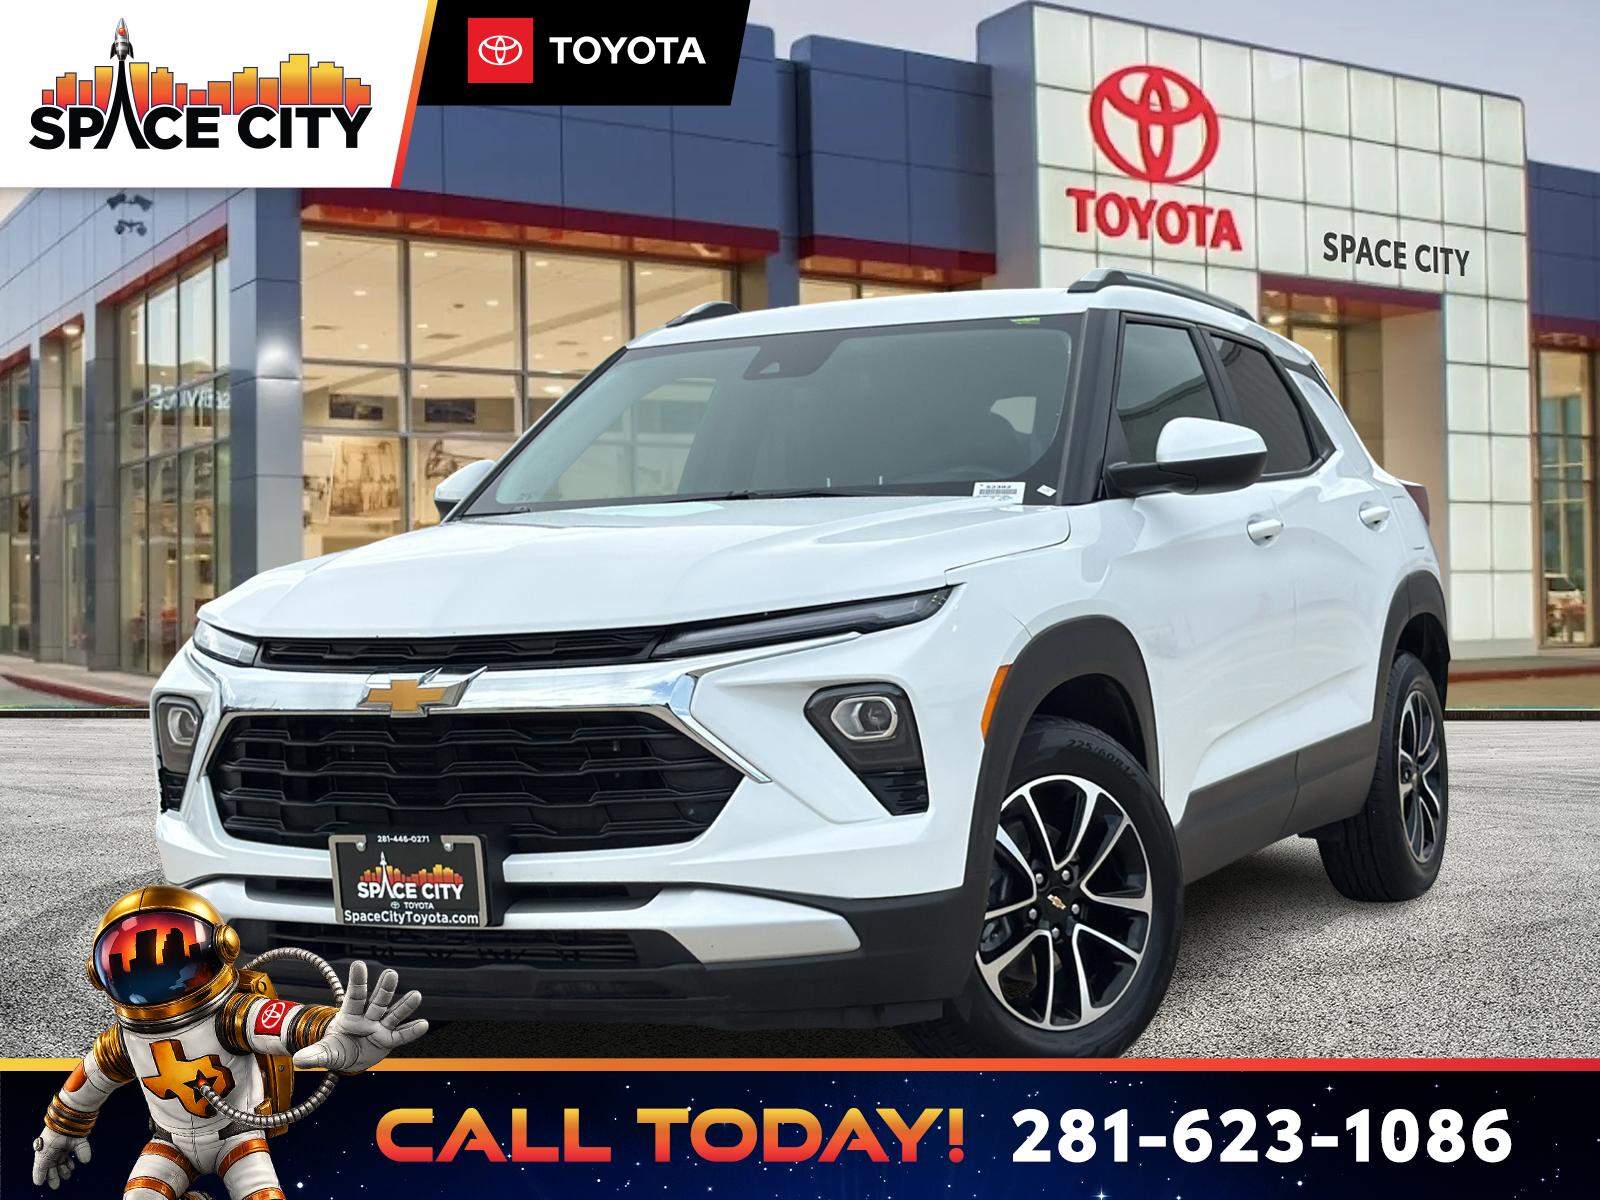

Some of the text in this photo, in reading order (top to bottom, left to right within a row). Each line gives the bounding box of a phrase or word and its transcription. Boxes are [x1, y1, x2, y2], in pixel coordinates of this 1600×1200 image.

[1066, 187, 1243, 251] TOYOTA
[1323, 231, 1471, 277] SPACE CITY
[357, 882, 464, 900] SPACE CITY
[403, 901, 434, 910] TOYOTA
[344, 910, 479, 925] SpaceCityToyota.com
